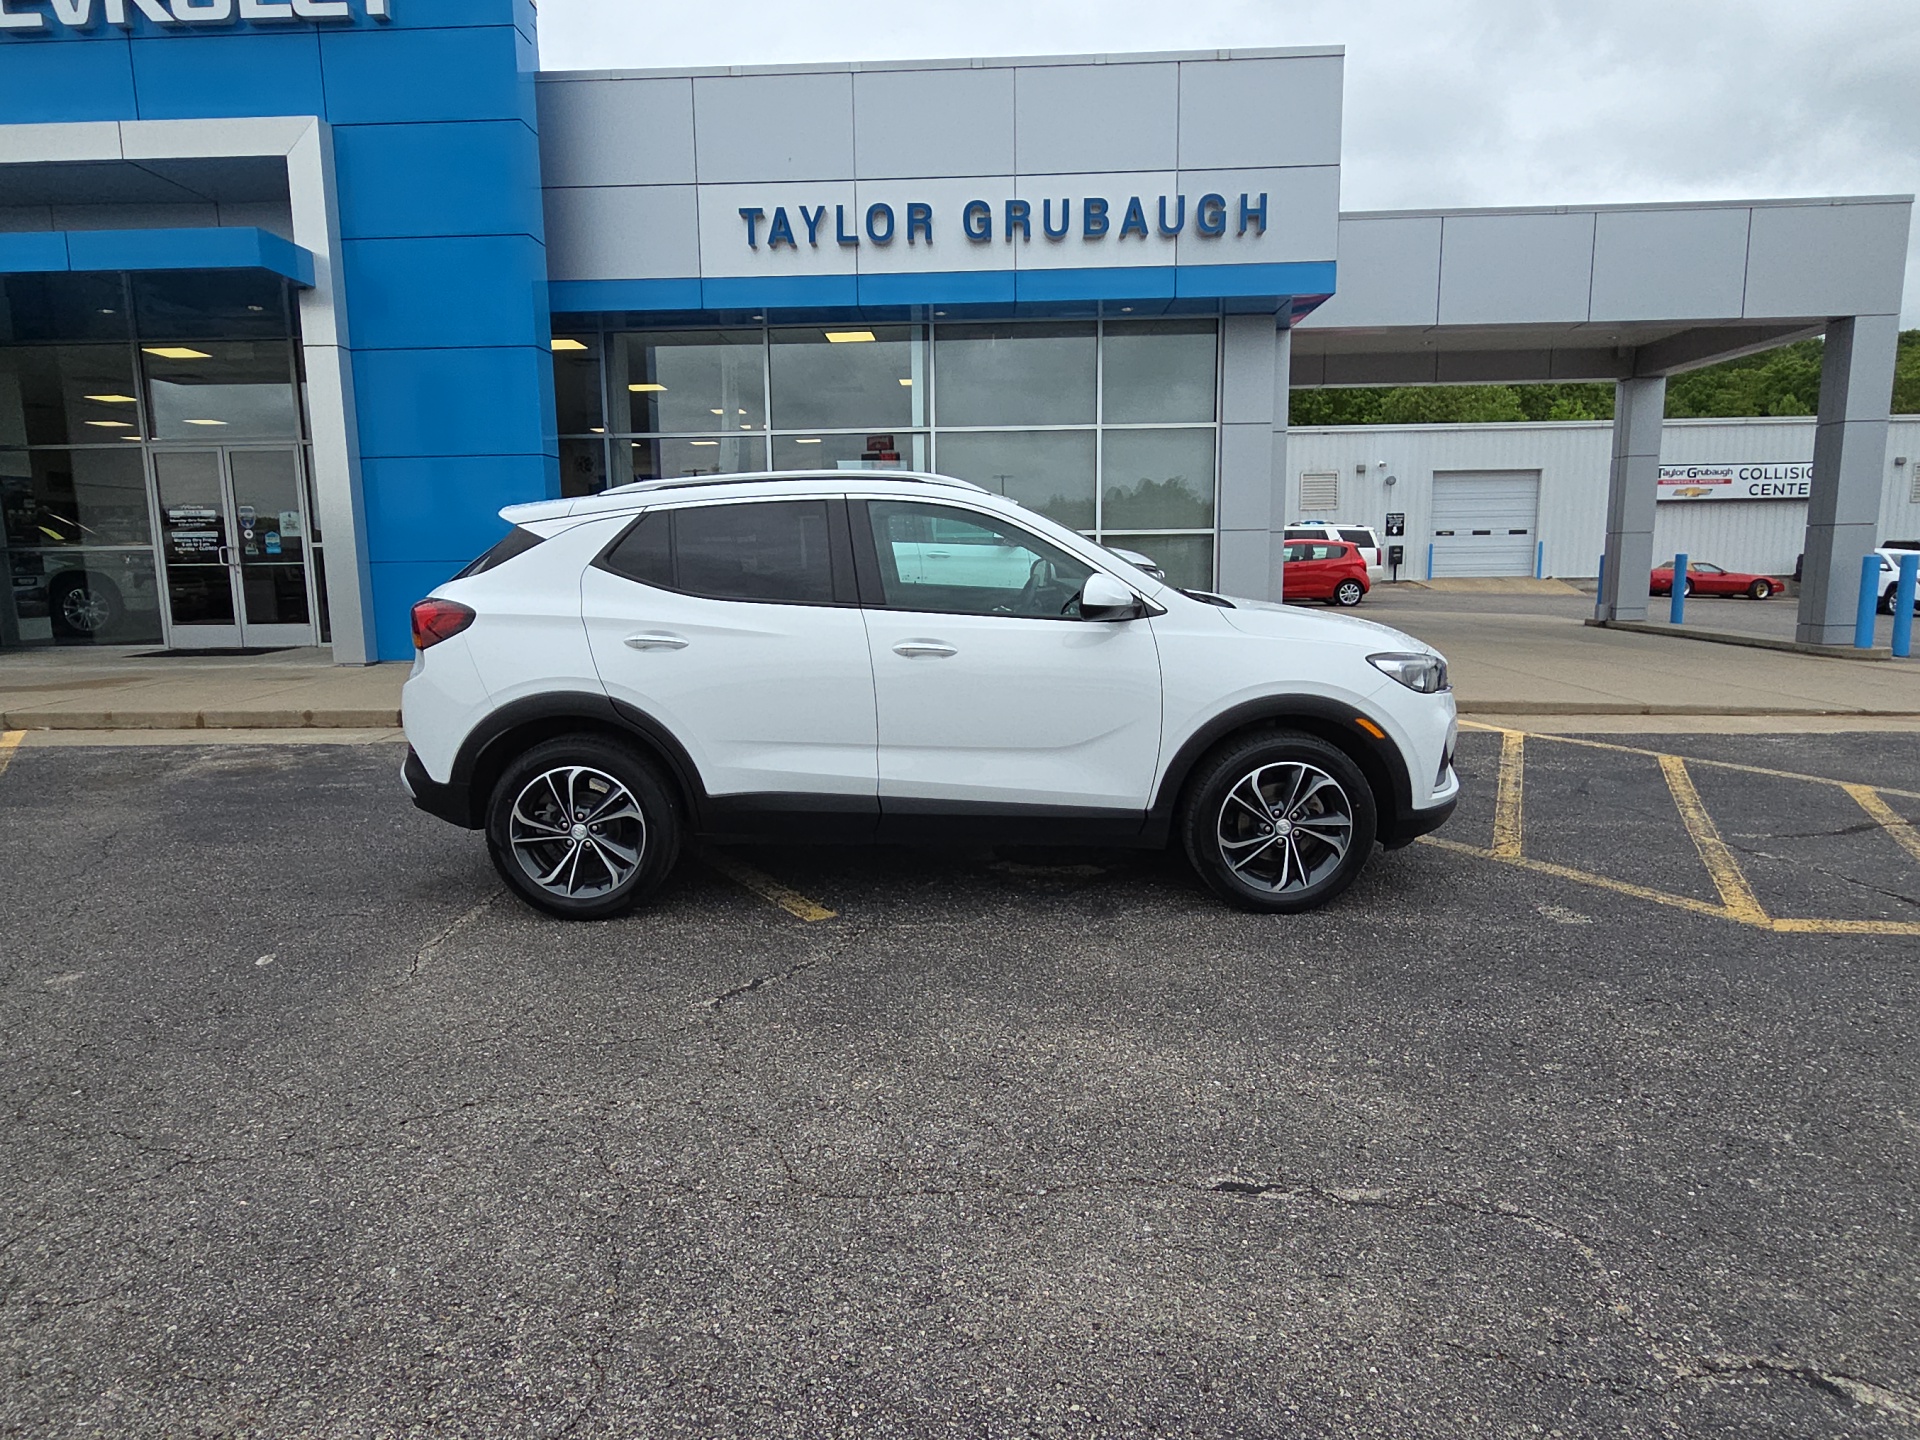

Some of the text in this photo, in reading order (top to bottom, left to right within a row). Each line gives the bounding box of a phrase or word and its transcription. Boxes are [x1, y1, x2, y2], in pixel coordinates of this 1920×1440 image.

[738, 193, 1268, 248] TAYLOR GRUBAUGH
[1658, 467, 1733, 479] Taylor Grubaugh
